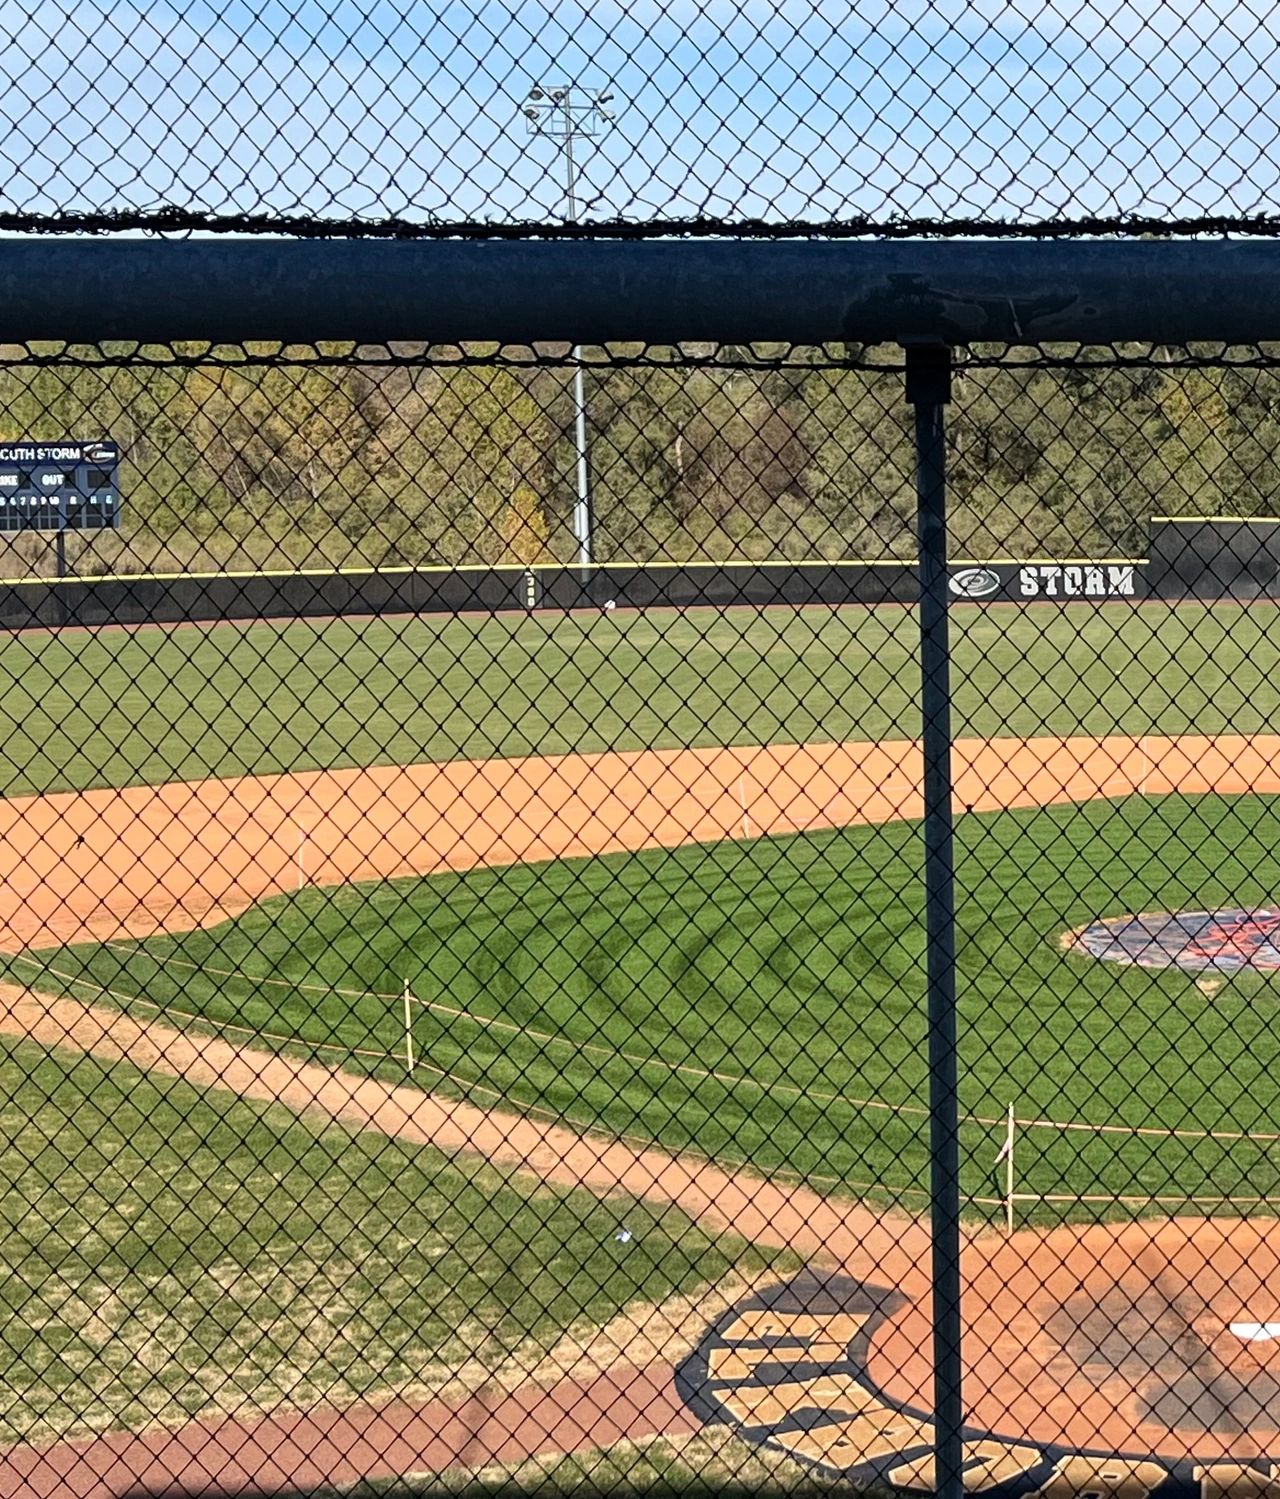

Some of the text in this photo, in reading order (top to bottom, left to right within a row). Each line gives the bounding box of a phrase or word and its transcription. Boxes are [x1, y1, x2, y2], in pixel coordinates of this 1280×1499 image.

[37, 448, 80, 460] STORM
[42, 474, 64, 486] OUT
[1020, 566, 1135, 596] STORM
